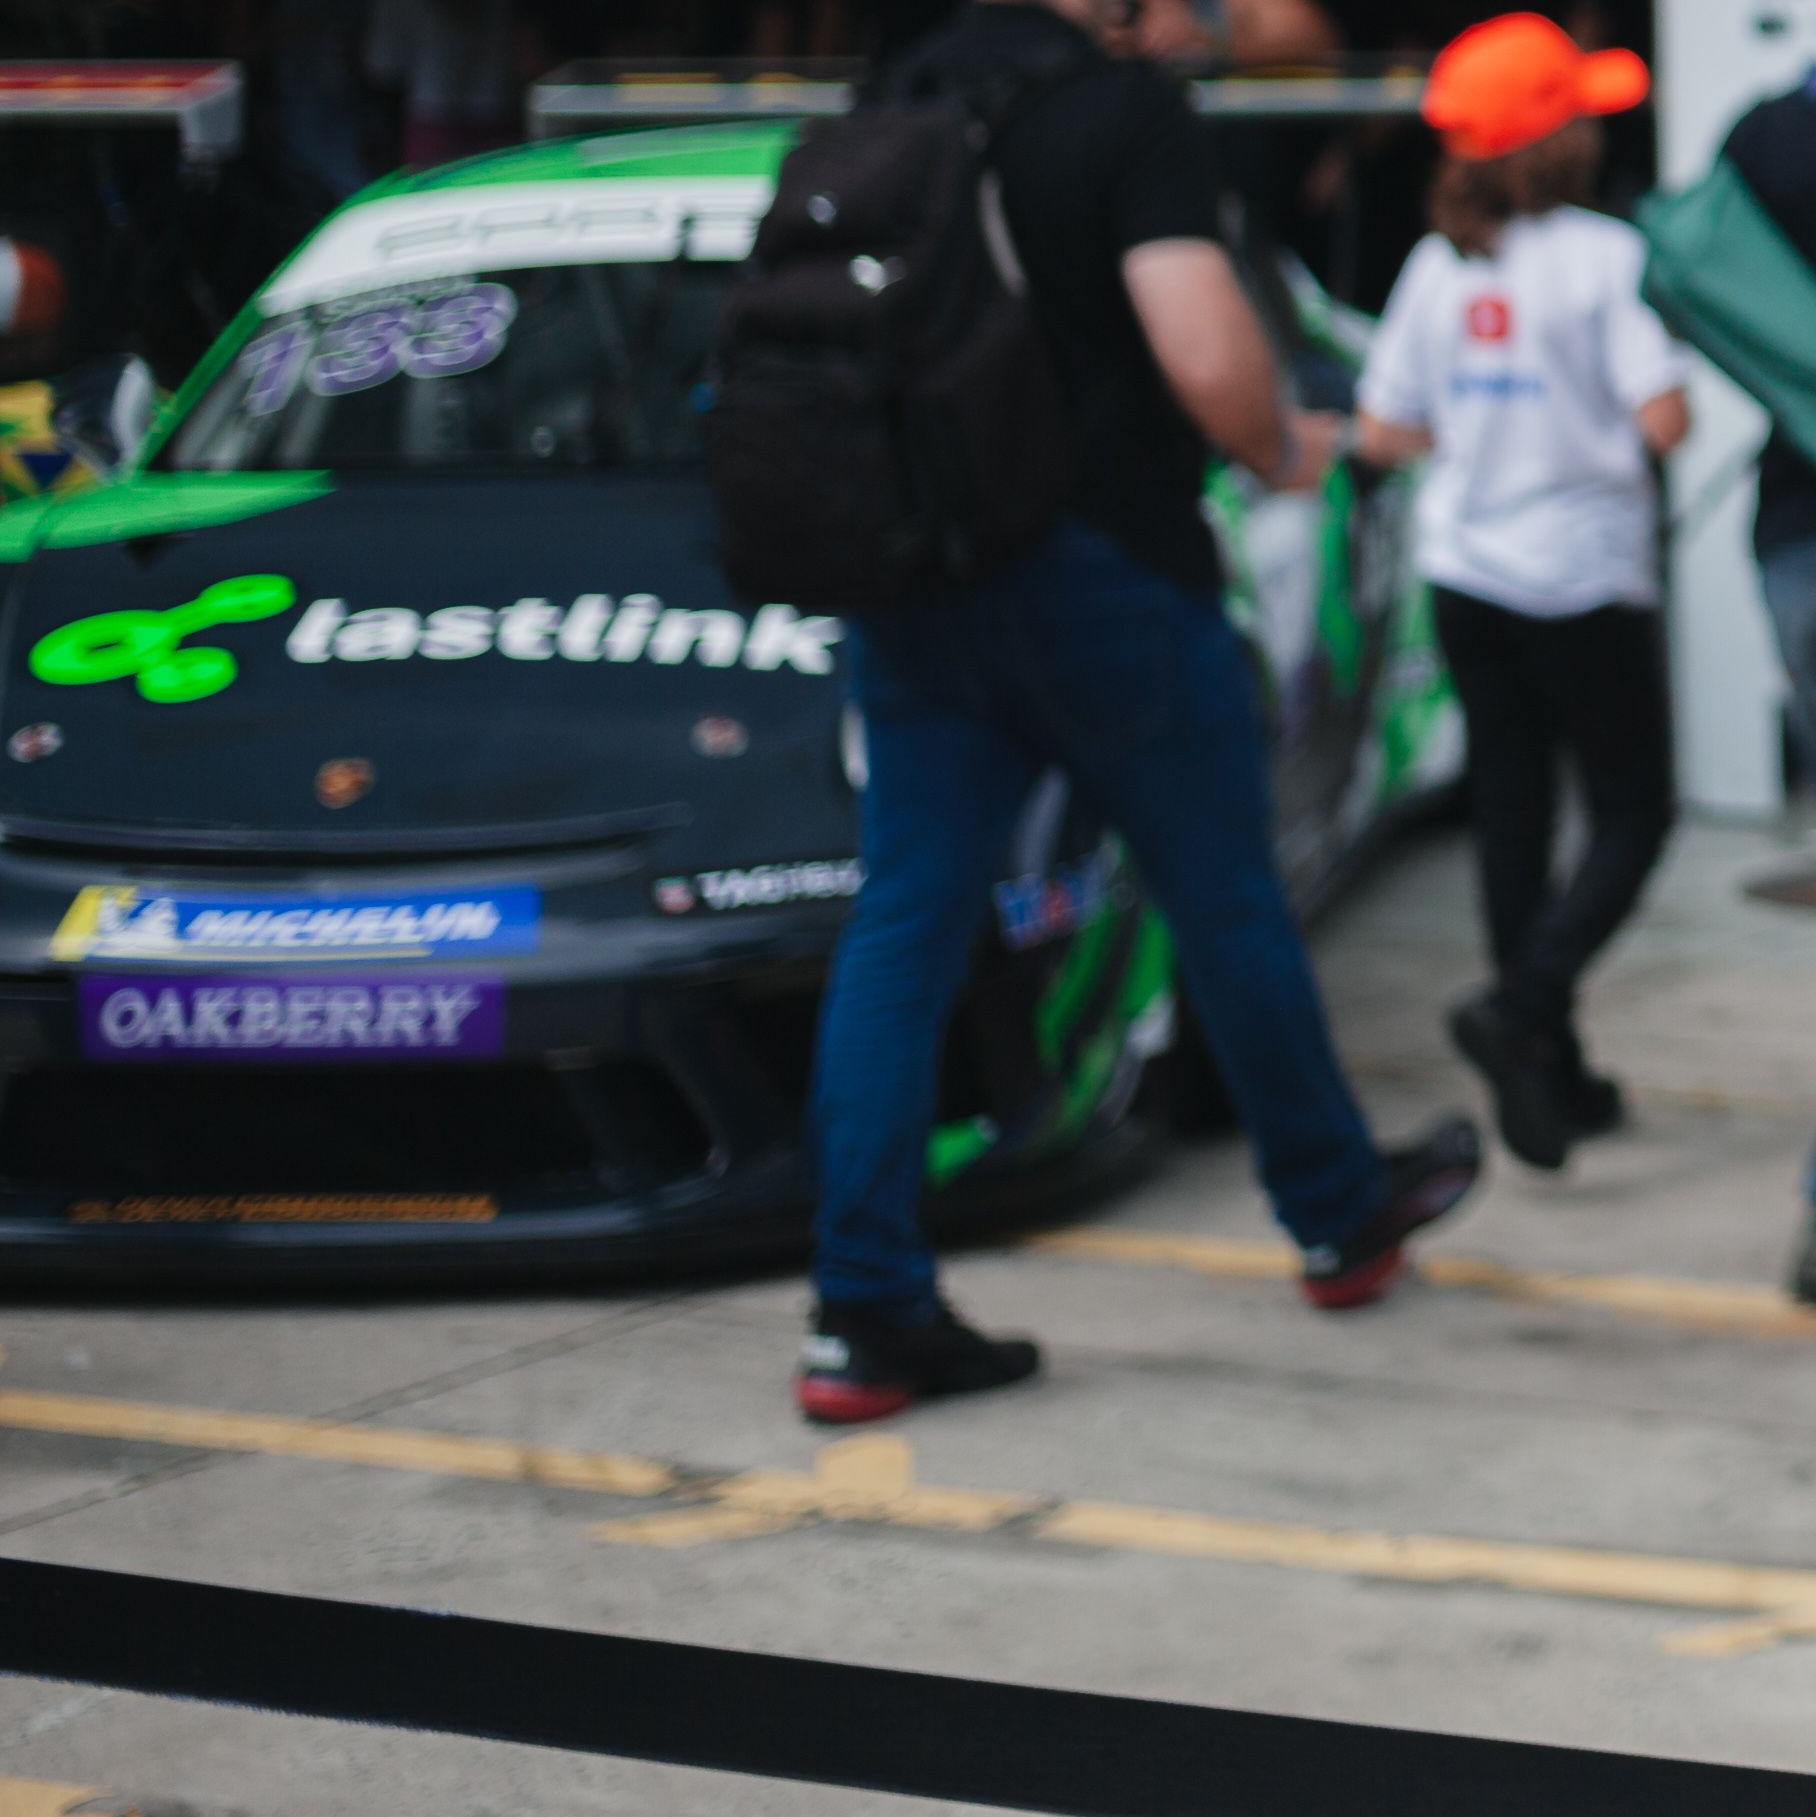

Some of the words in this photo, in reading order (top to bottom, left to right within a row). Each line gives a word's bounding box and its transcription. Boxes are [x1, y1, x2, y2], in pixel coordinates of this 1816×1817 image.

[242, 282, 518, 416] 133
[284, 593, 848, 676] lastlink
[185, 900, 502, 949] MICHELIN
[101, 985, 482, 1049] OAKBERRY
